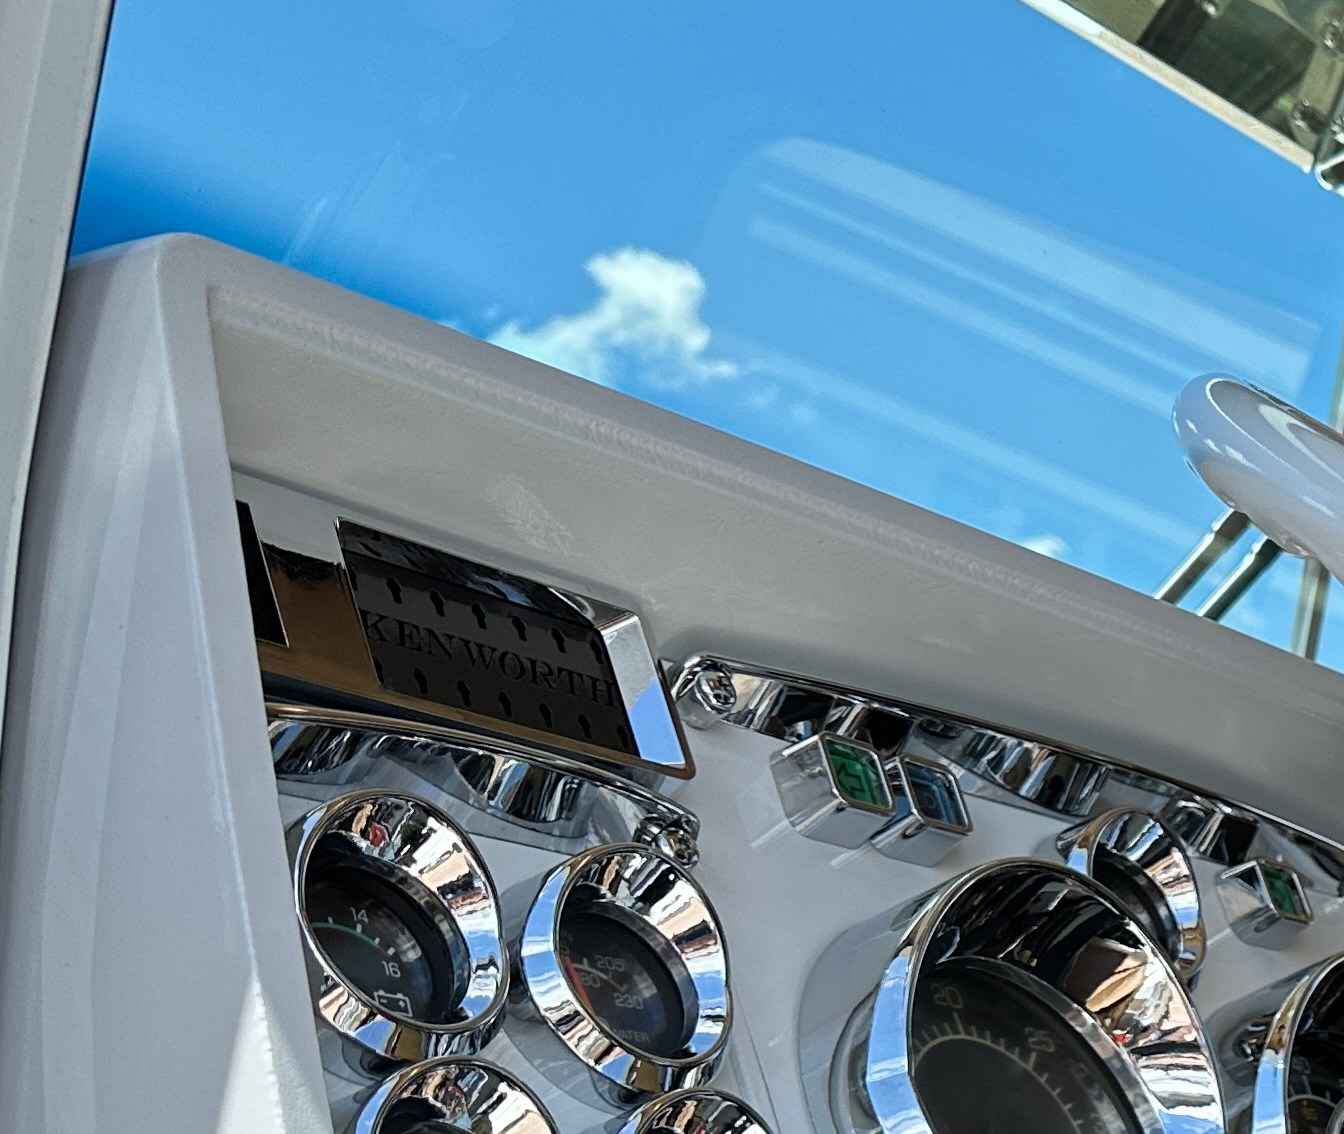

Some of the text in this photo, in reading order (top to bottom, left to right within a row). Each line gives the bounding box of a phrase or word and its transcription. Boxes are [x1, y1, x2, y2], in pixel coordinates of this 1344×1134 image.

[359, 610, 619, 708] KENWORTH
[350, 907, 369, 925] 14
[382, 960, 401, 979] 16
[596, 954, 625, 973] 205
[612, 992, 644, 1010] 230
[930, 982, 964, 1009] 20
[1023, 1026, 1057, 1053] 25
